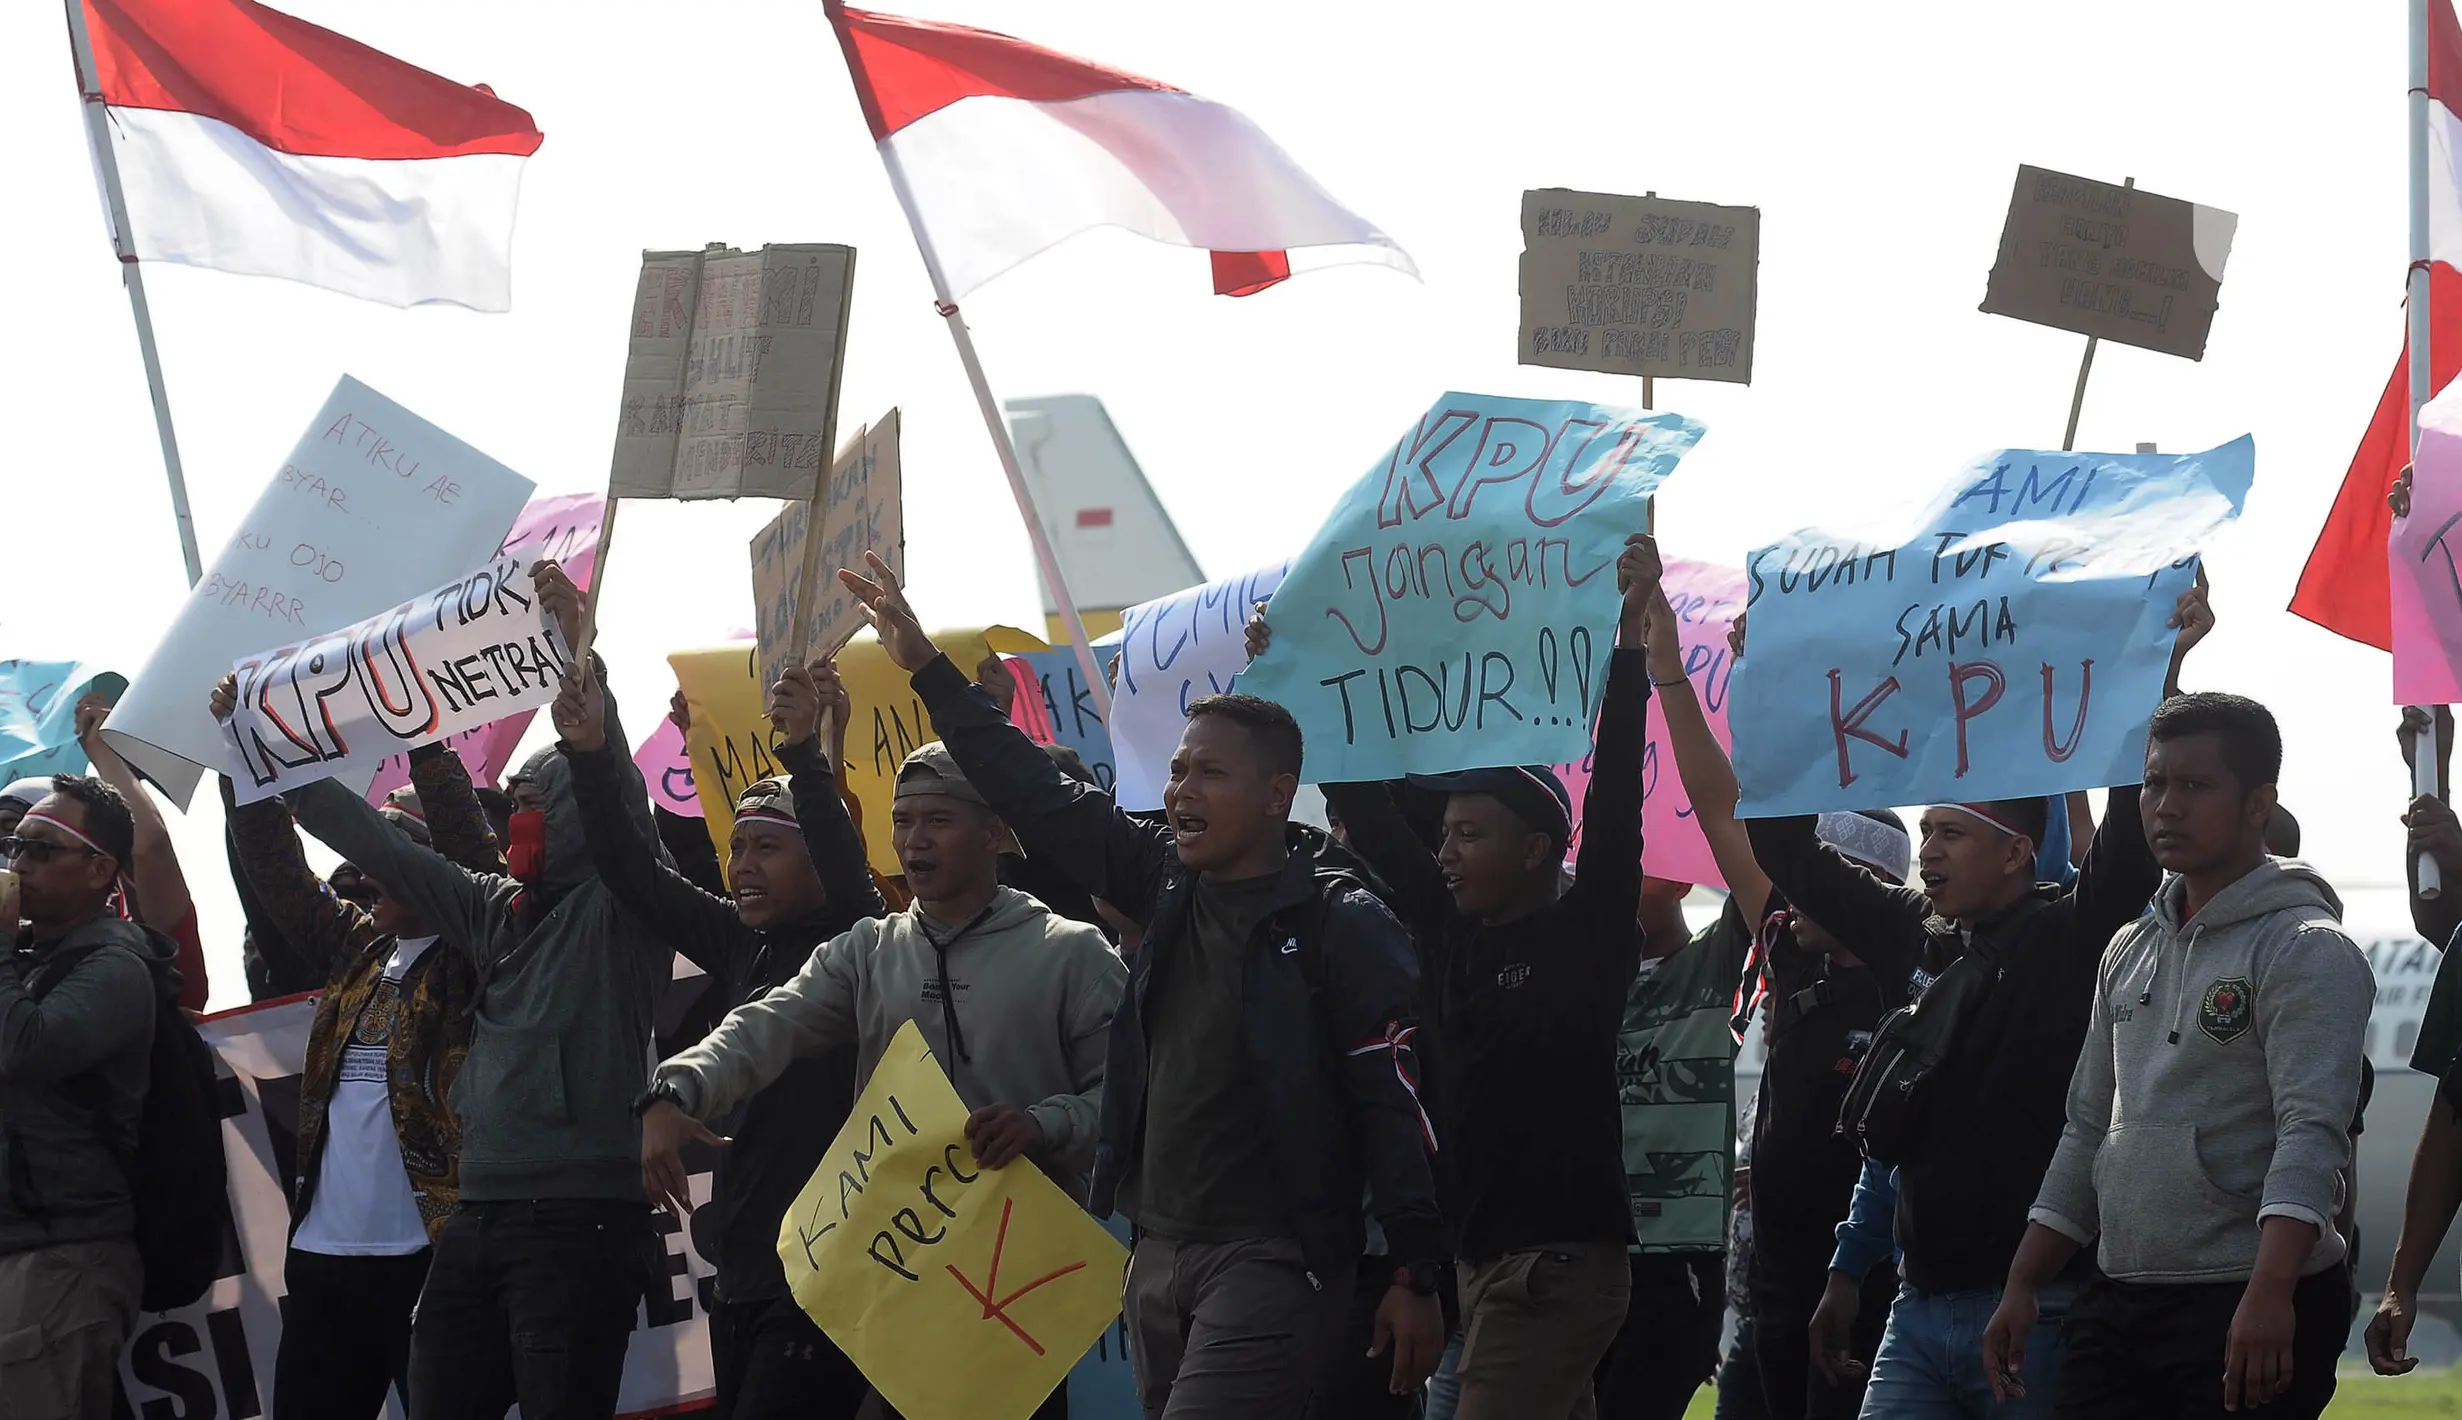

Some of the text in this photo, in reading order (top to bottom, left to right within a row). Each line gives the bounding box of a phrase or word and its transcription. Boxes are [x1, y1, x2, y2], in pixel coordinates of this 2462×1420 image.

[1567, 284, 1687, 329] KORUPSI
[1377, 408, 1651, 530] KPU
[1746, 544, 1896, 609] SUDAH
[1892, 596, 2018, 667] SAMA
[231, 603, 439, 785] KPU
[1826, 657, 2096, 790] KPU
[799, 1095, 918, 1271] KAMI
